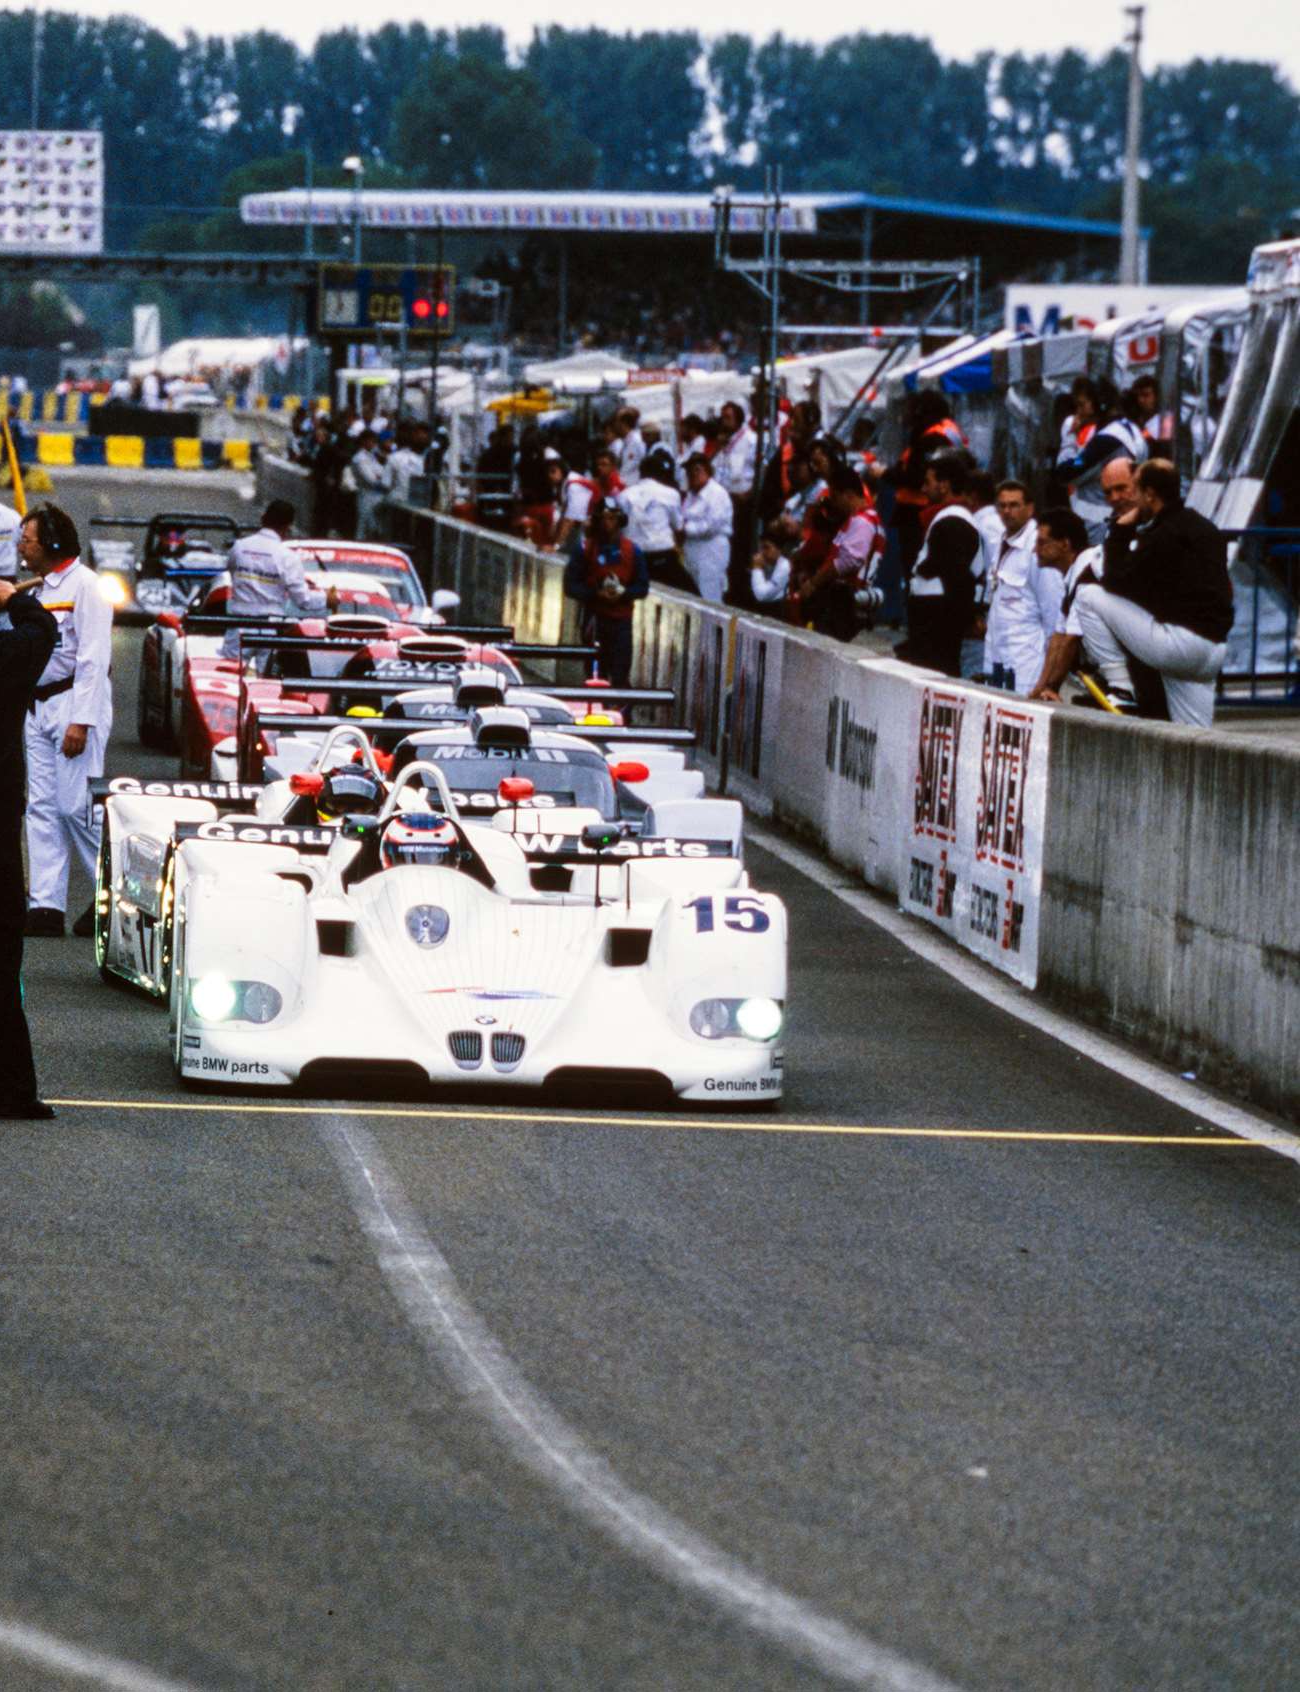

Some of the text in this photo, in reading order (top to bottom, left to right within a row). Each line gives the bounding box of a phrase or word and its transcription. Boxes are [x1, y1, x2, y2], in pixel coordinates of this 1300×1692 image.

[433, 746, 530, 761] Mobil
[108, 777, 263, 800] Genuin
[196, 822, 342, 846] Genu
[682, 896, 770, 934] 15
[202, 1056, 229, 1071] BMW
[231, 1061, 269, 1075] parts
[704, 1077, 759, 1092] Genuine
